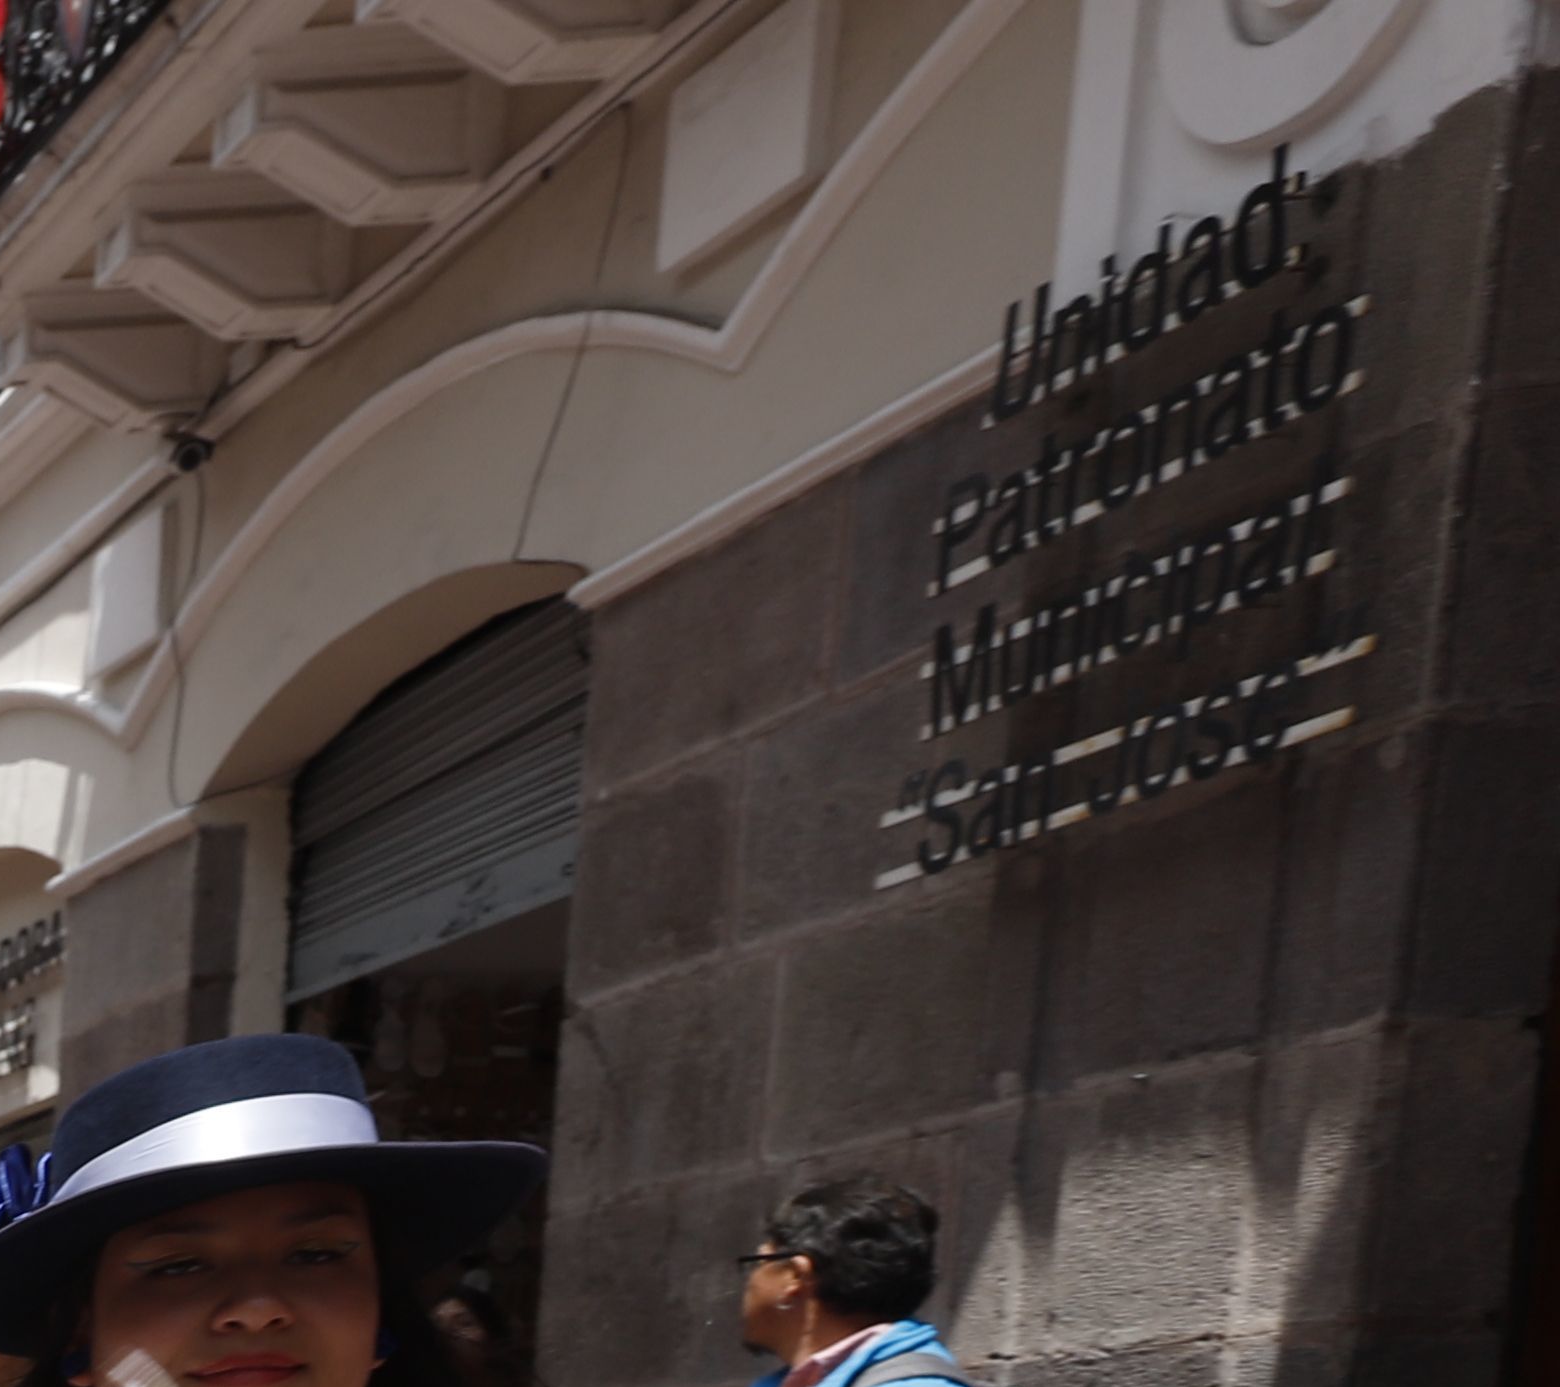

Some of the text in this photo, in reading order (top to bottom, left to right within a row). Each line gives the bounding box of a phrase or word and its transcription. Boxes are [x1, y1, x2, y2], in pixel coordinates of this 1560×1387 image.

[992, 142, 1289, 420] Unidad
[930, 446, 1336, 738] Municipal
[936, 304, 1353, 593] Patronato
